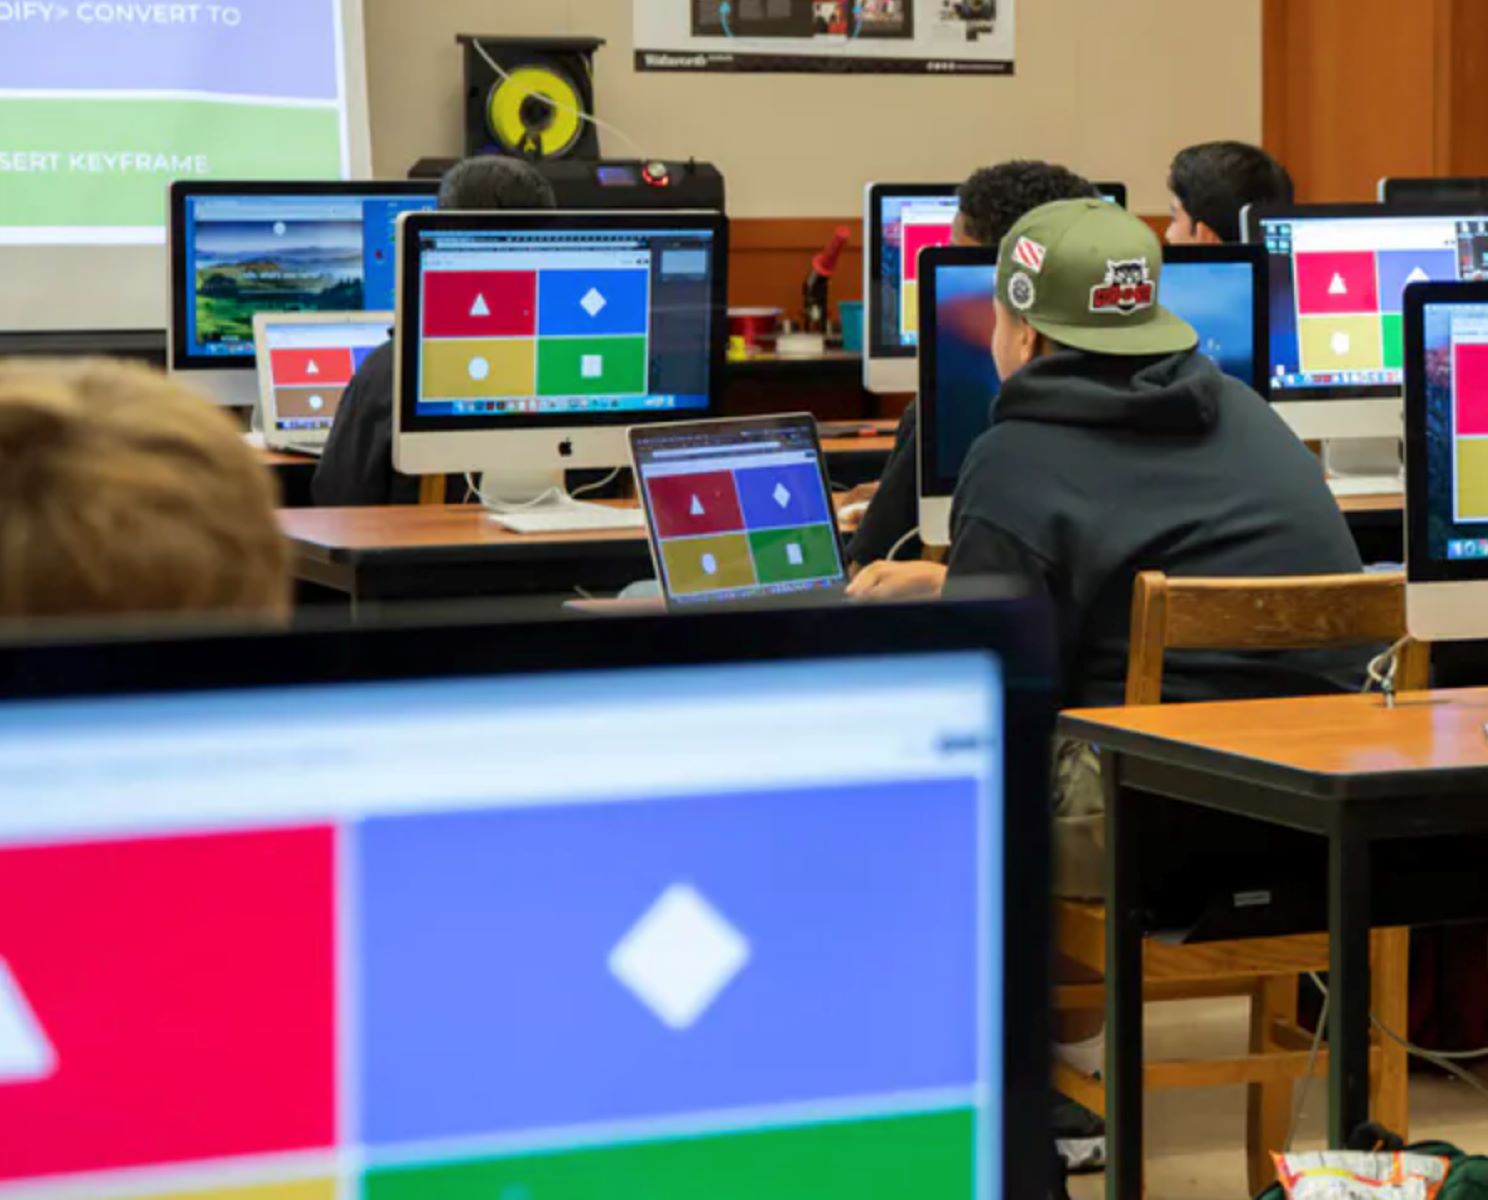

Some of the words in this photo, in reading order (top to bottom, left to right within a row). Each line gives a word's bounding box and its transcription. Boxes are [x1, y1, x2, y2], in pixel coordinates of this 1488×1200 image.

[76, 4, 200, 24] CONVERT
[207, 4, 242, 27] TO
[0, 151, 58, 172] SERT
[69, 152, 209, 174] KEYFRAME
